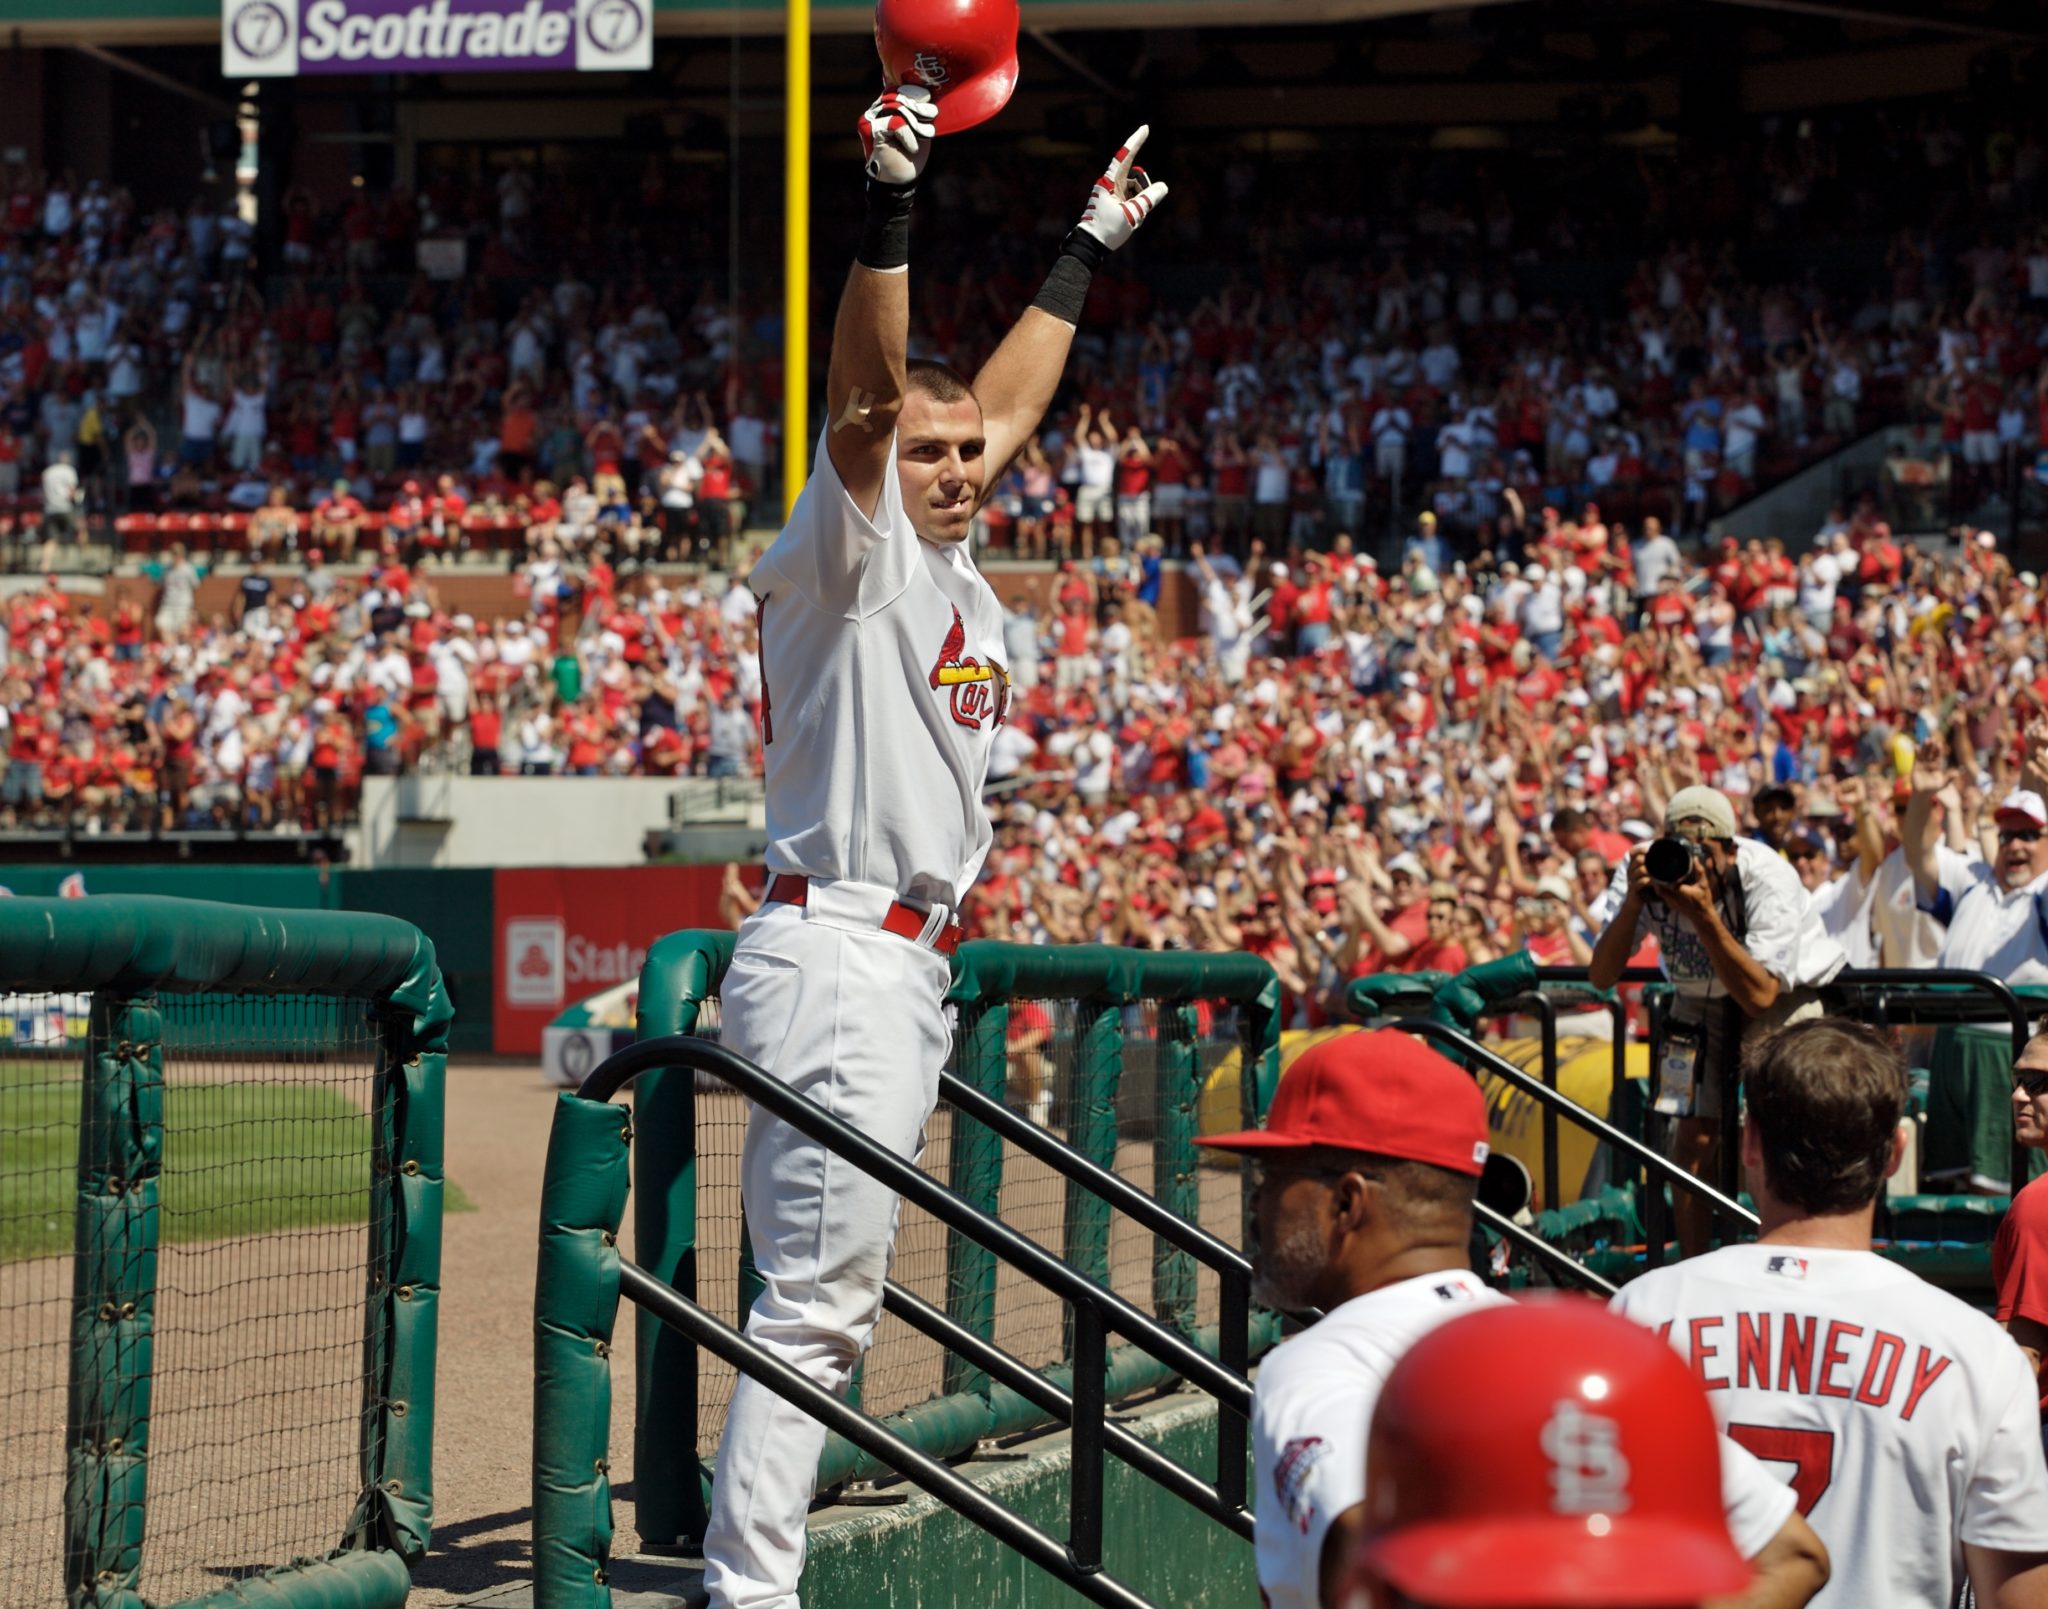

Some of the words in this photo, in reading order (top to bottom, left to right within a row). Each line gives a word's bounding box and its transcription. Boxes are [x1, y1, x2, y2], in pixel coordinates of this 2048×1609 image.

[249, 12, 272, 48] 7
[300, 0, 571, 60] Scottrade
[604, 6, 627, 41] 7
[1648, 1311, 1952, 1422] ENNEDY
[1727, 1422, 1834, 1518] 7
